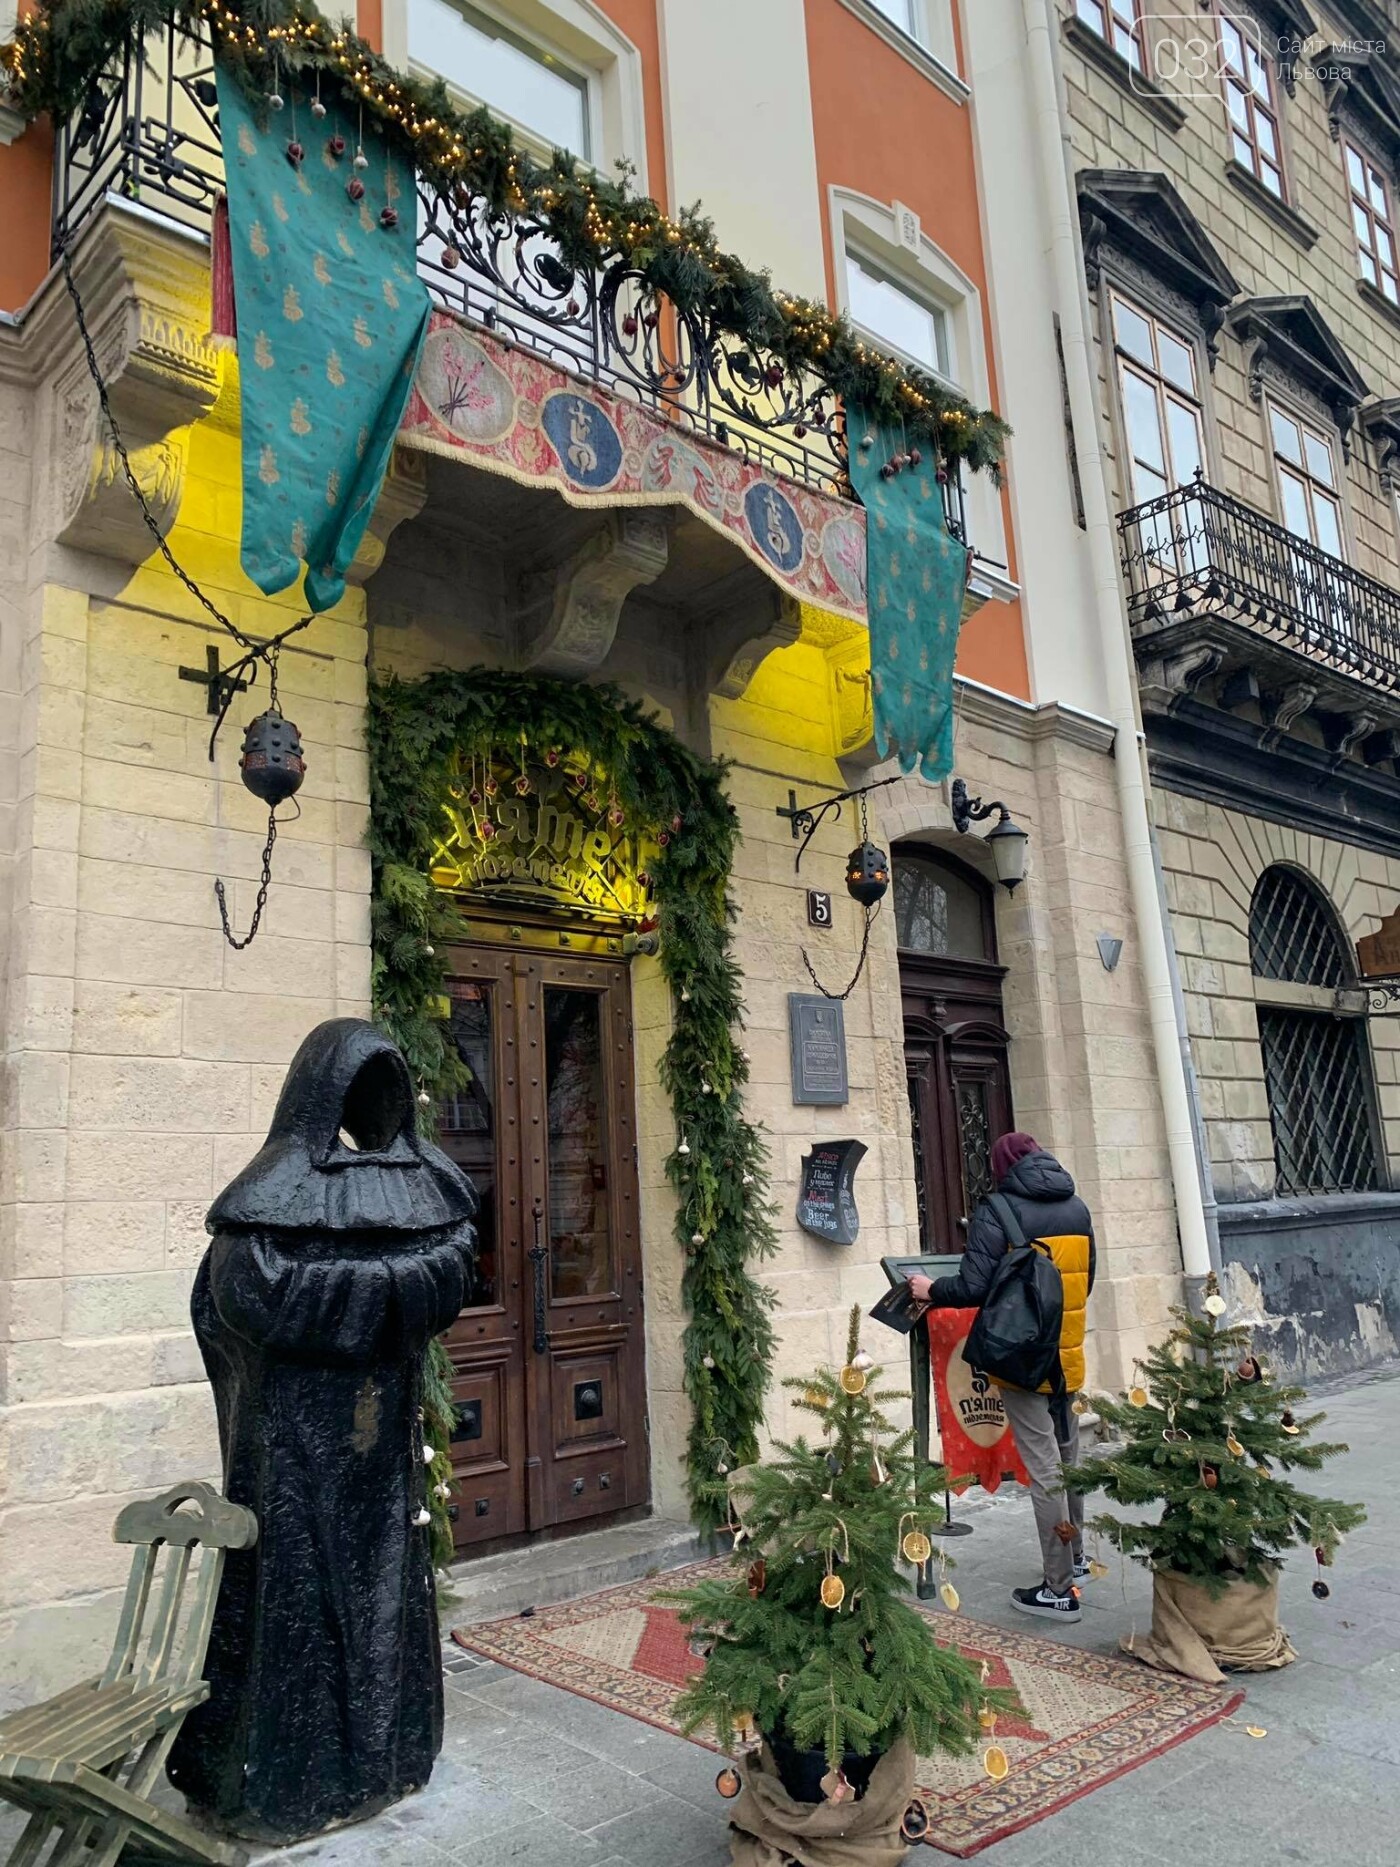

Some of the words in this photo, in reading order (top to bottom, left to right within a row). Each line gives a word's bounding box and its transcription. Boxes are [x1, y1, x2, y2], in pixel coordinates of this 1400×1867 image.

[815, 894, 828, 921] 5
[808, 1209, 829, 1221] Beer
[1054, 1600, 1069, 1609] AIR
